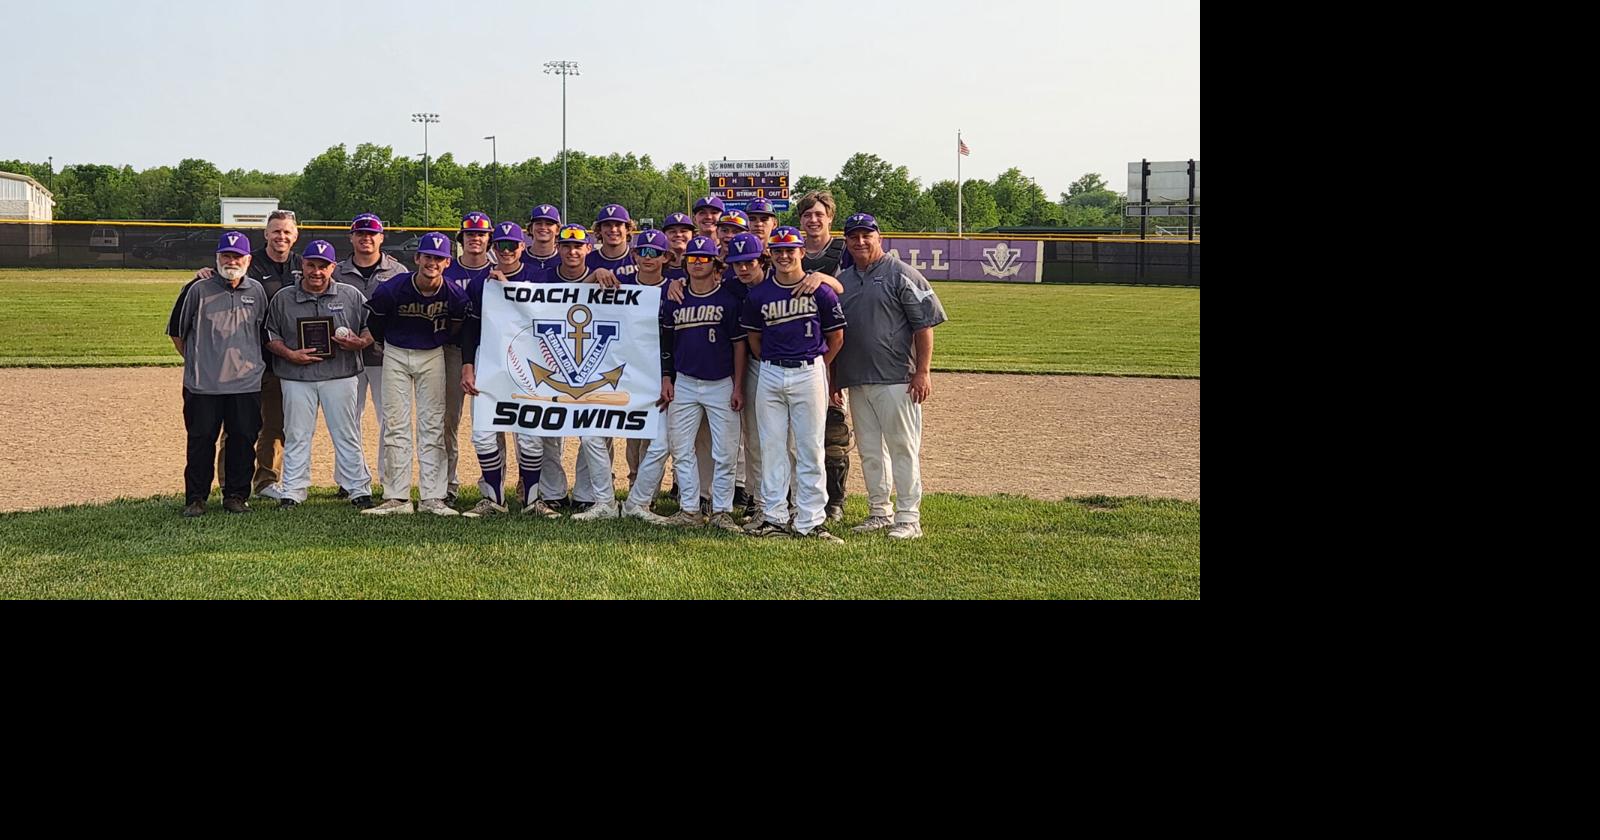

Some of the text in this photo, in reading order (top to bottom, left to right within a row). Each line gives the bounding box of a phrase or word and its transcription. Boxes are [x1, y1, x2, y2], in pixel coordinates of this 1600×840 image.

[719, 177, 725, 187] 0
[748, 176, 754, 186] 7
[780, 176, 787, 186] 5
[727, 189, 733, 198] 0
[757, 188, 763, 198] 0
[782, 188, 788, 198] 0
[540, 206, 551, 214] V
[606, 206, 616, 216] V
[729, 210, 739, 218] V
[470, 215, 480, 223] V
[674, 213, 683, 222] V
[502, 225, 512, 235] V
[778, 230, 789, 239] V
[228, 236, 239, 246] V
[432, 237, 443, 249] V
[646, 233, 656, 243] V
[317, 244, 327, 254] V
[695, 239, 705, 249] V
[735, 241, 745, 253] V
[503, 286, 642, 305] COACH KECK
[761, 296, 818, 321] SAILORS
[672, 305, 724, 324] SAILORS
[434, 319, 446, 333] 11
[804, 321, 814, 337] 1
[708, 328, 716, 343] 6
[545, 328, 575, 374] VERMILION
[574, 343, 606, 383] BASEBALL
[492, 401, 567, 430] 500
